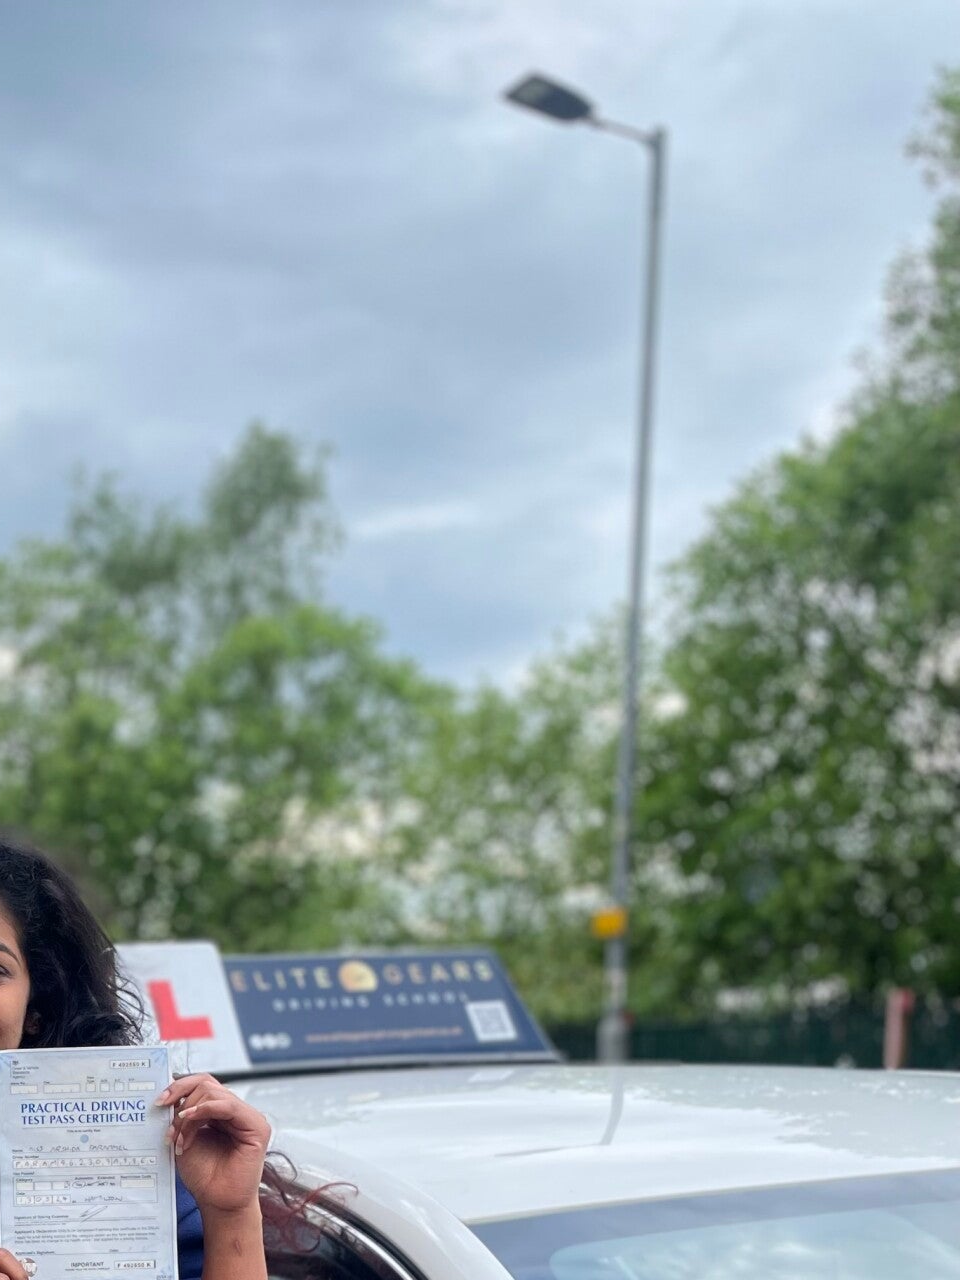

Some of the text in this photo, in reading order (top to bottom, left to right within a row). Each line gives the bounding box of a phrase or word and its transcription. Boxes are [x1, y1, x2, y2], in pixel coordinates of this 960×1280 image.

[229, 959, 494, 993] ELITE GEARS
[146, 978, 214, 1041] L
[21, 1100, 146, 1113] PRACTICAL DRIVING
[22, 1112, 146, 1125] TEST PASS CERTIFICATE
